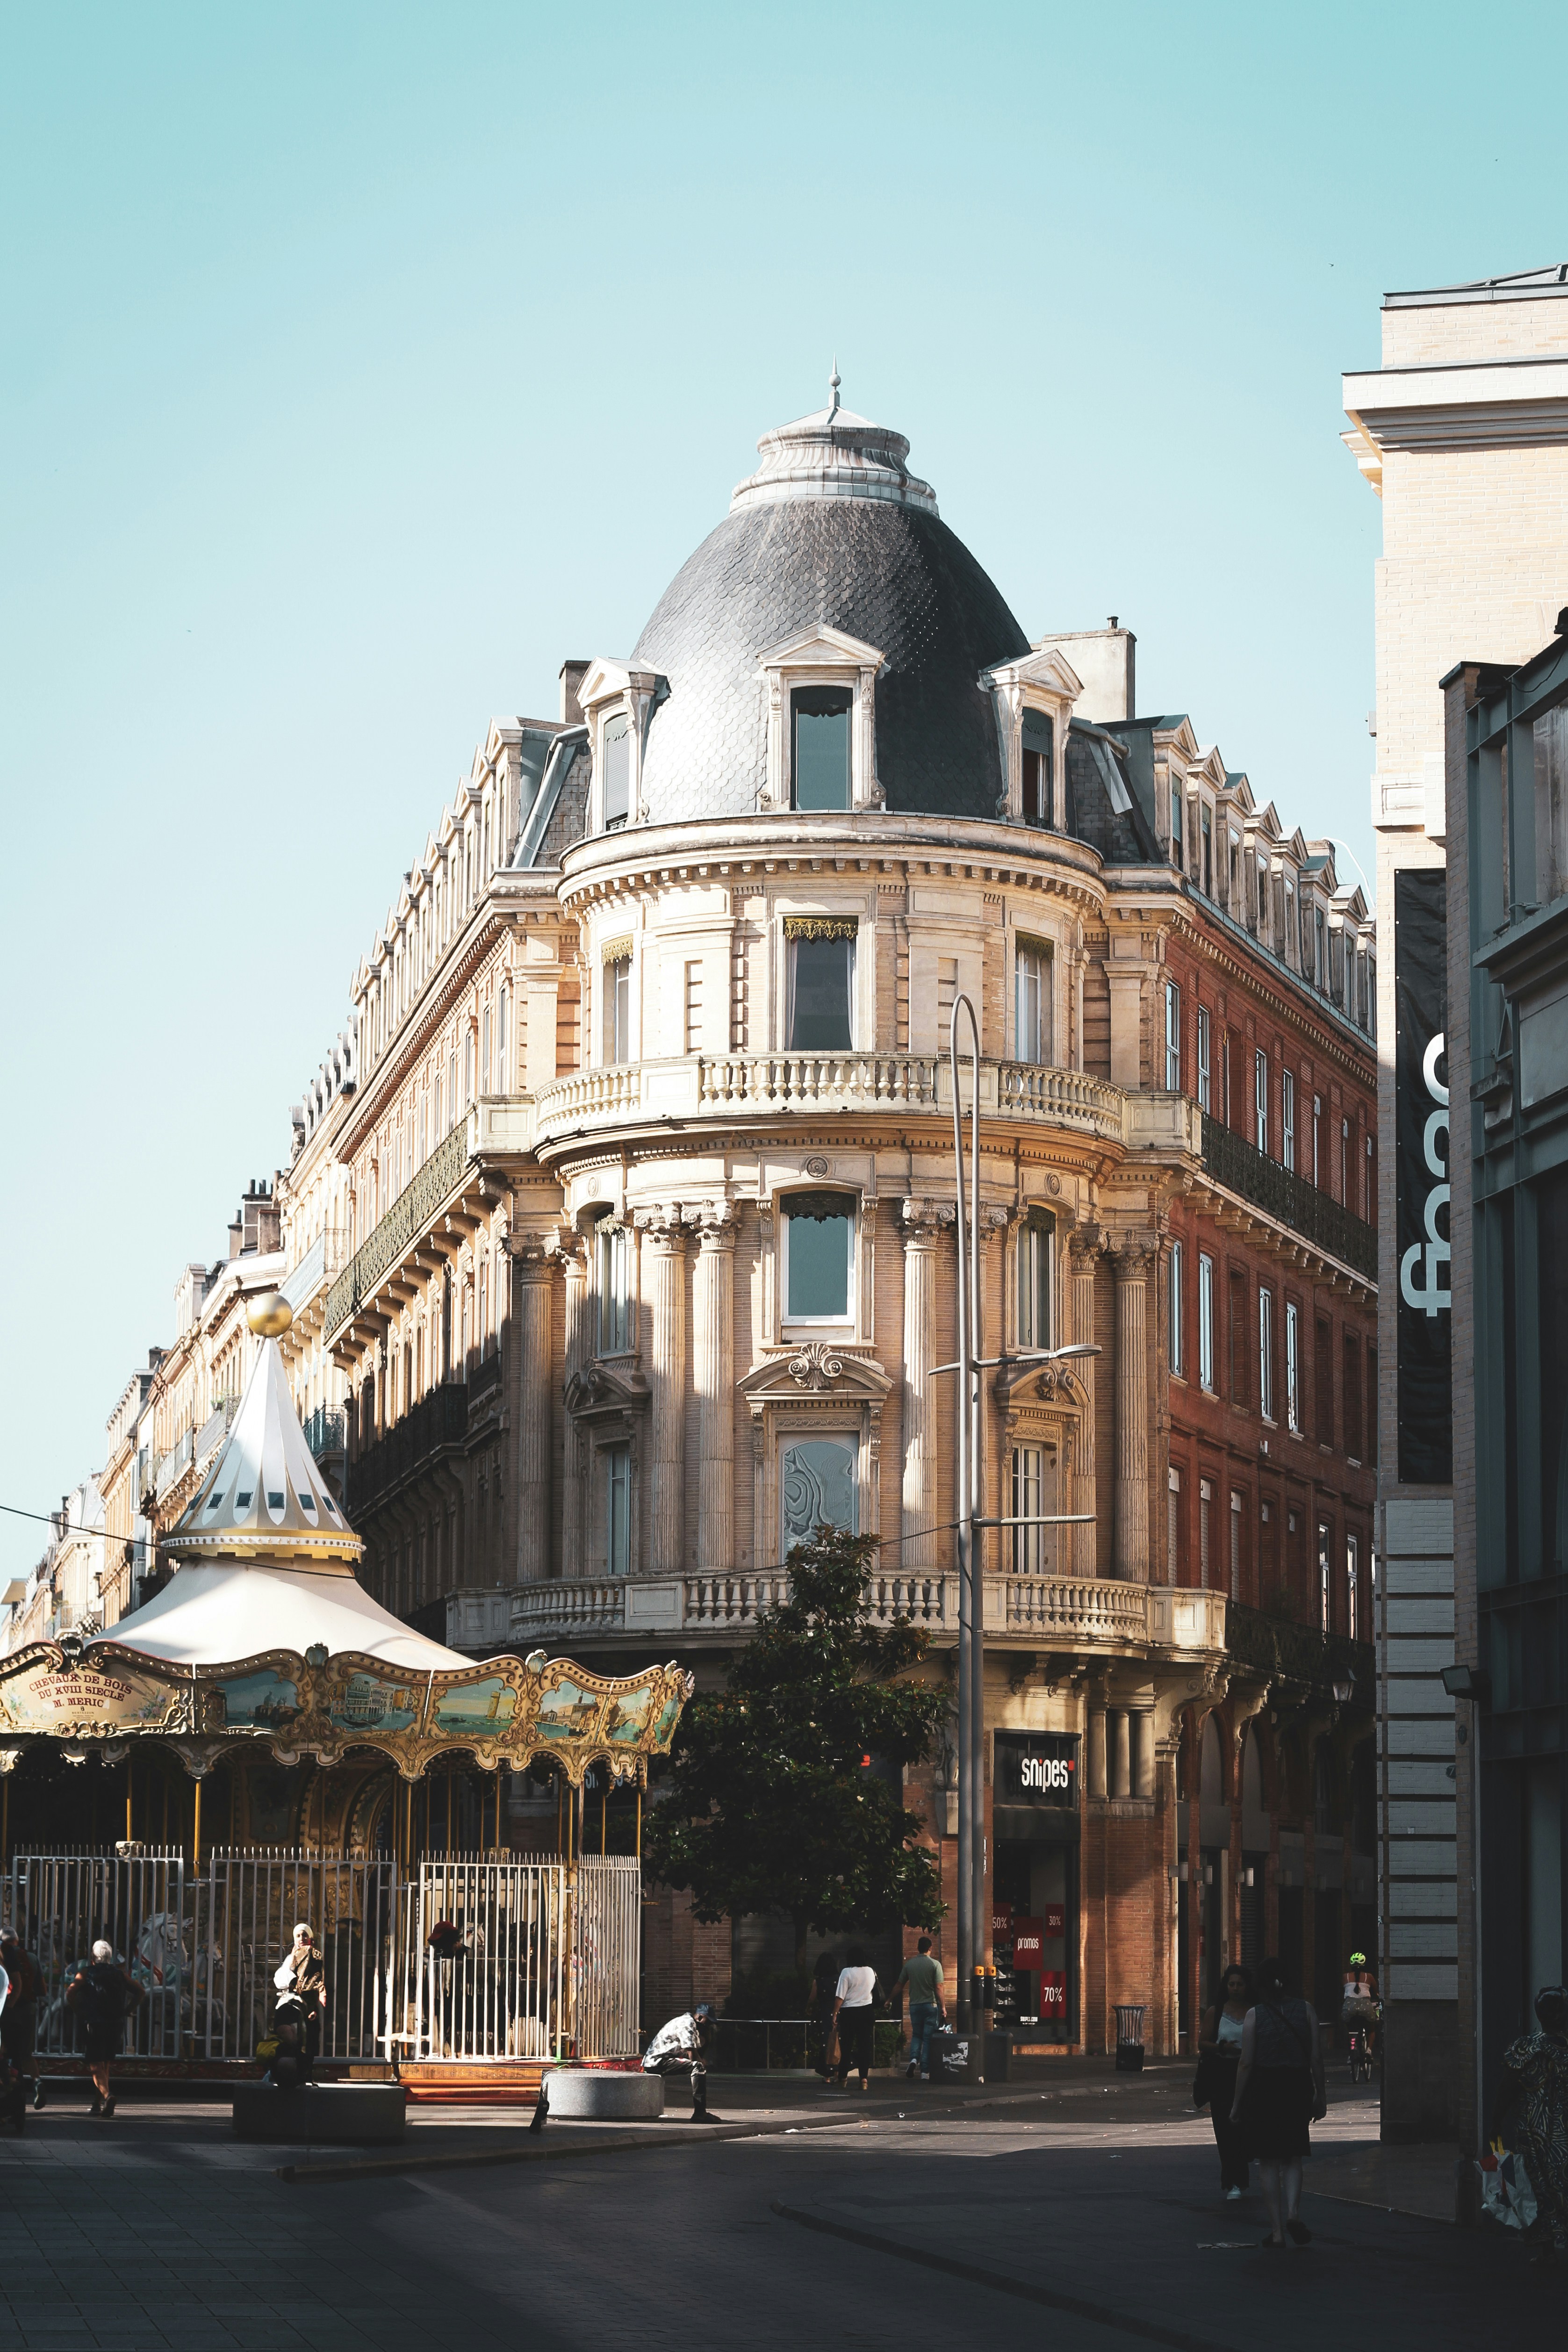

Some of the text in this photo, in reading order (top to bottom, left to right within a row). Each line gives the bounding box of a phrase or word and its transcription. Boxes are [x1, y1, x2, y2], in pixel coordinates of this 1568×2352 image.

[29, 1674, 133, 1695] CHEVAUX DE BOIS
[38, 1685, 125, 1702] DU XVIII SIECLE
[53, 1697, 104, 1708] M. MERIC
[1021, 1758, 1068, 1792] snipes
[992, 1917, 1007, 1929] 50%
[1049, 1915, 1061, 1926] 30%
[1018, 1937, 1039, 1951] promos
[1044, 1987, 1063, 2002] 70%
